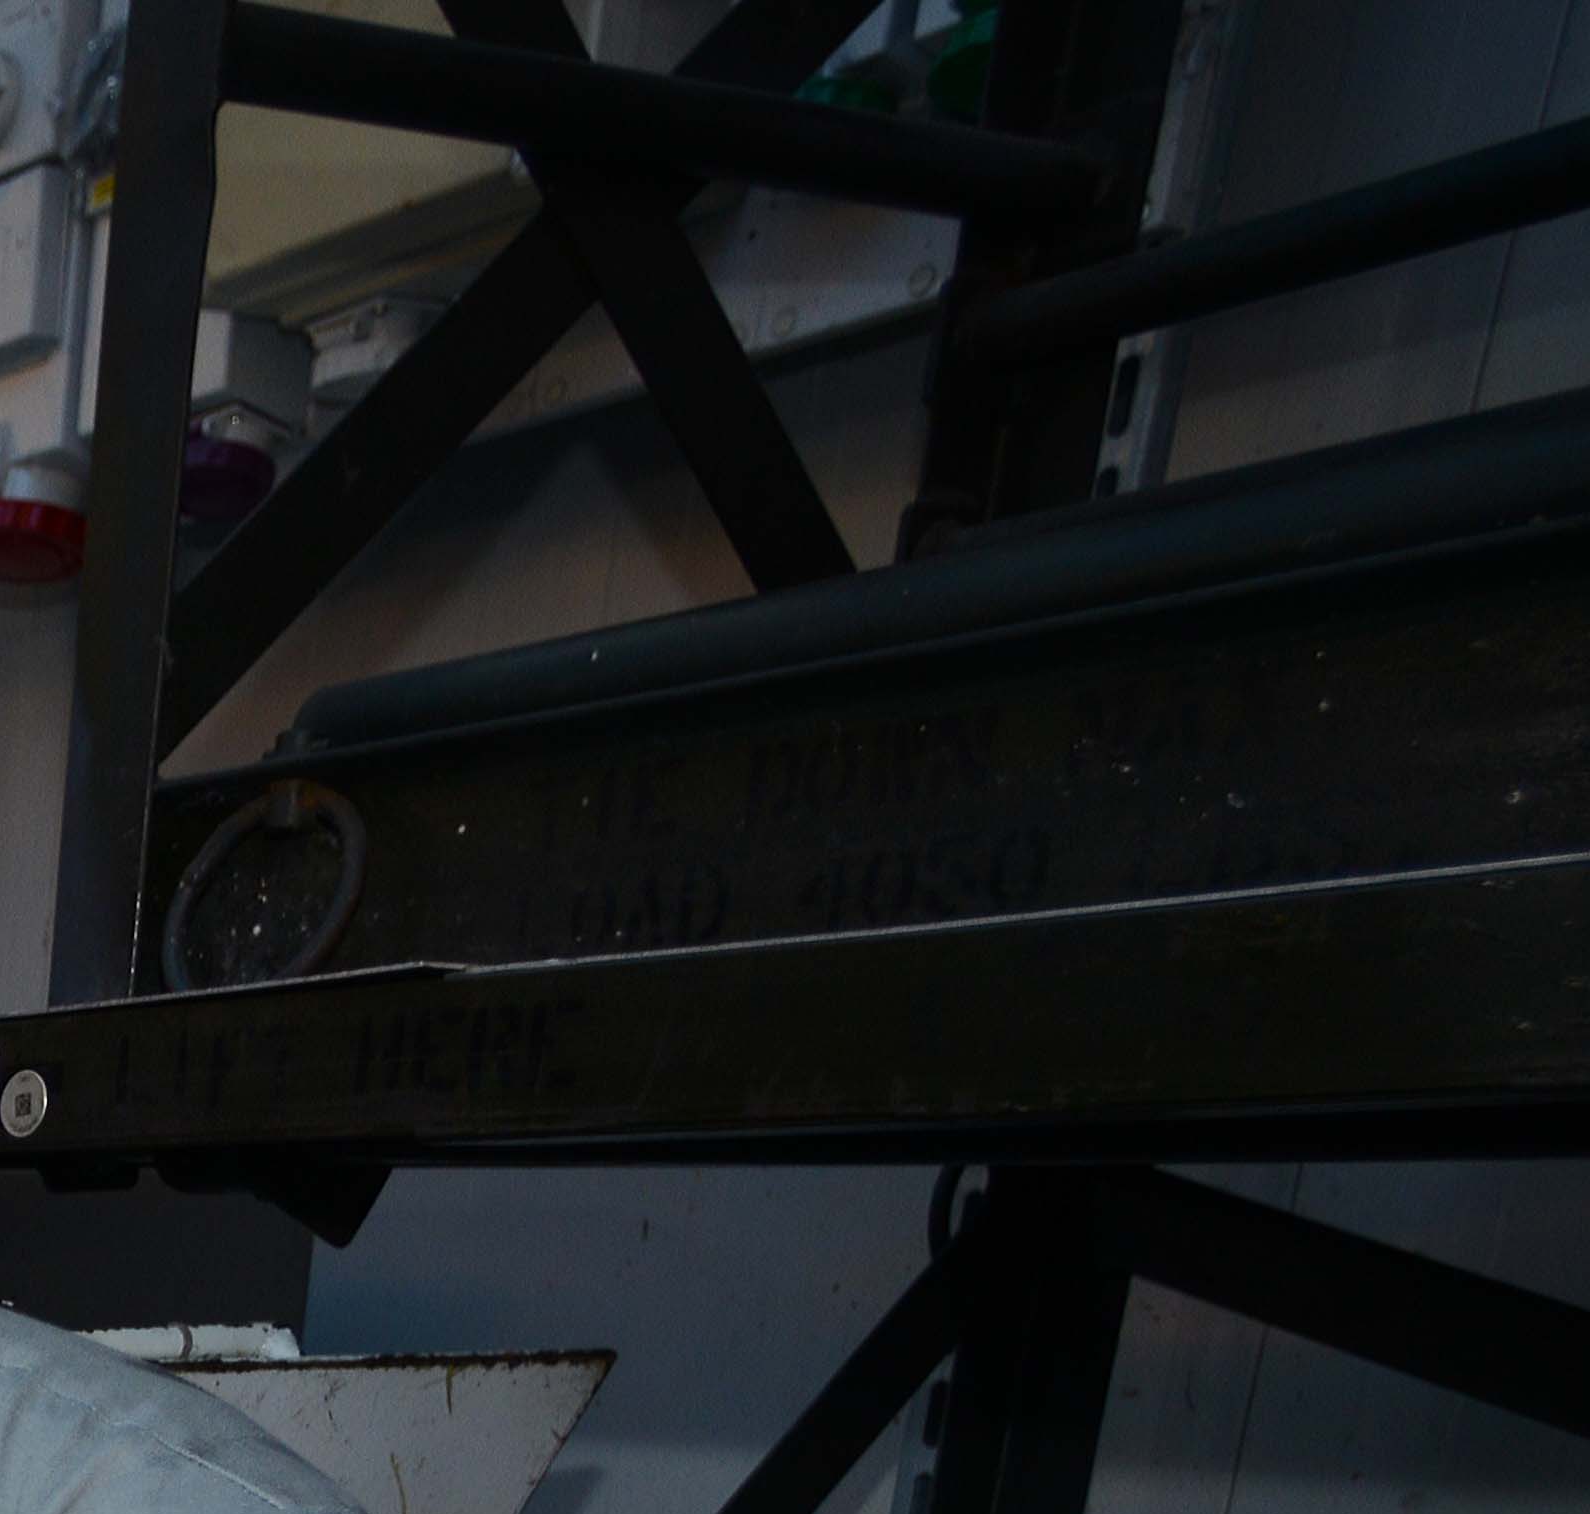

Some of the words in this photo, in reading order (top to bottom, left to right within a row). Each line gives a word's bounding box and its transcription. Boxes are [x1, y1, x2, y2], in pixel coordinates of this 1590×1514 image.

[743, 704, 1000, 824] DOWN
[513, 861, 729, 954] LOAD
[115, 1026, 300, 1109] LIFT
[353, 997, 585, 1094] HERE
